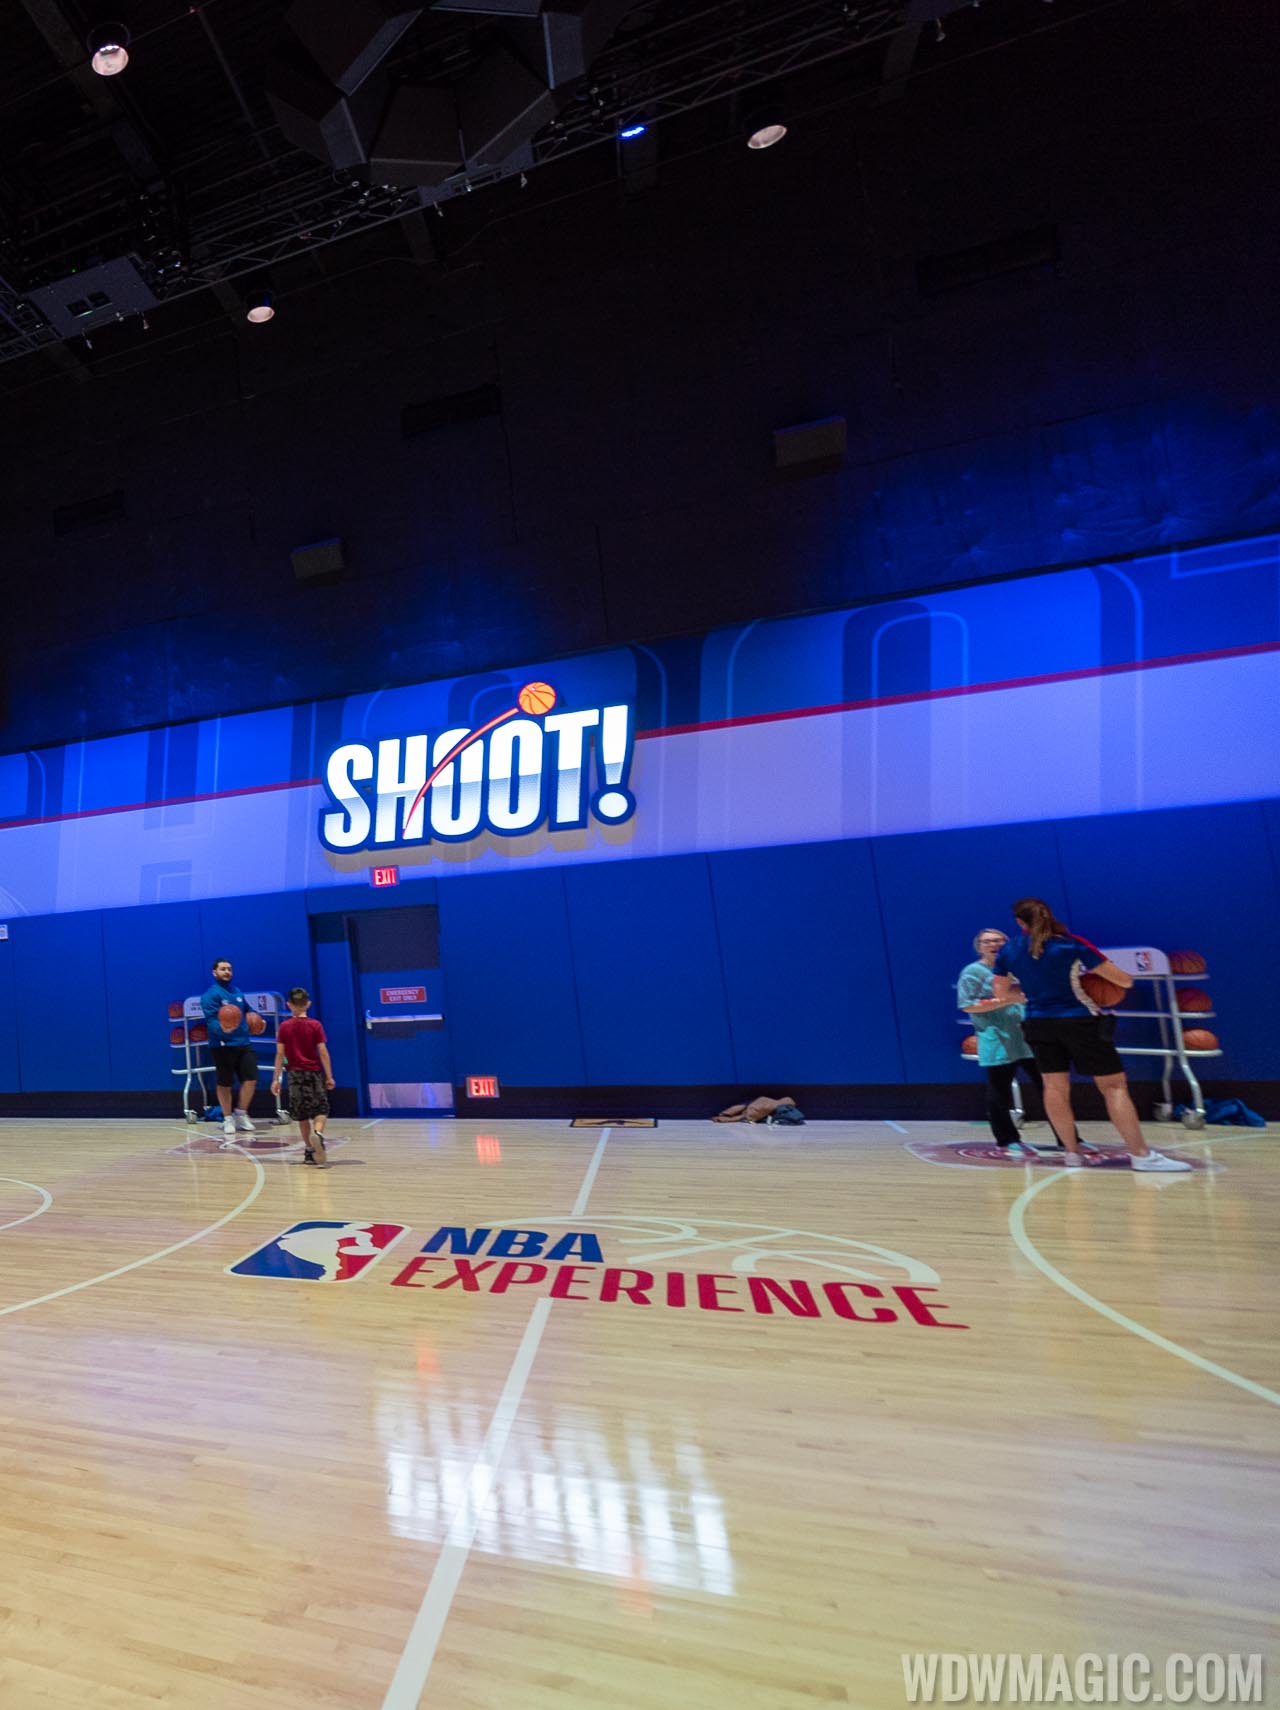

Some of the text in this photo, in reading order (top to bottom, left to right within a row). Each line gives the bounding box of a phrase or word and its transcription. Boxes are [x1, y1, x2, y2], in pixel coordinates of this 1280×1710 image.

[323, 704, 629, 848] SHOOT!
[374, 868, 397, 886] EXIT
[469, 1078, 496, 1097] EXIT
[420, 1225, 605, 1264] NBA
[389, 1256, 970, 1330] EXPERIENCE
